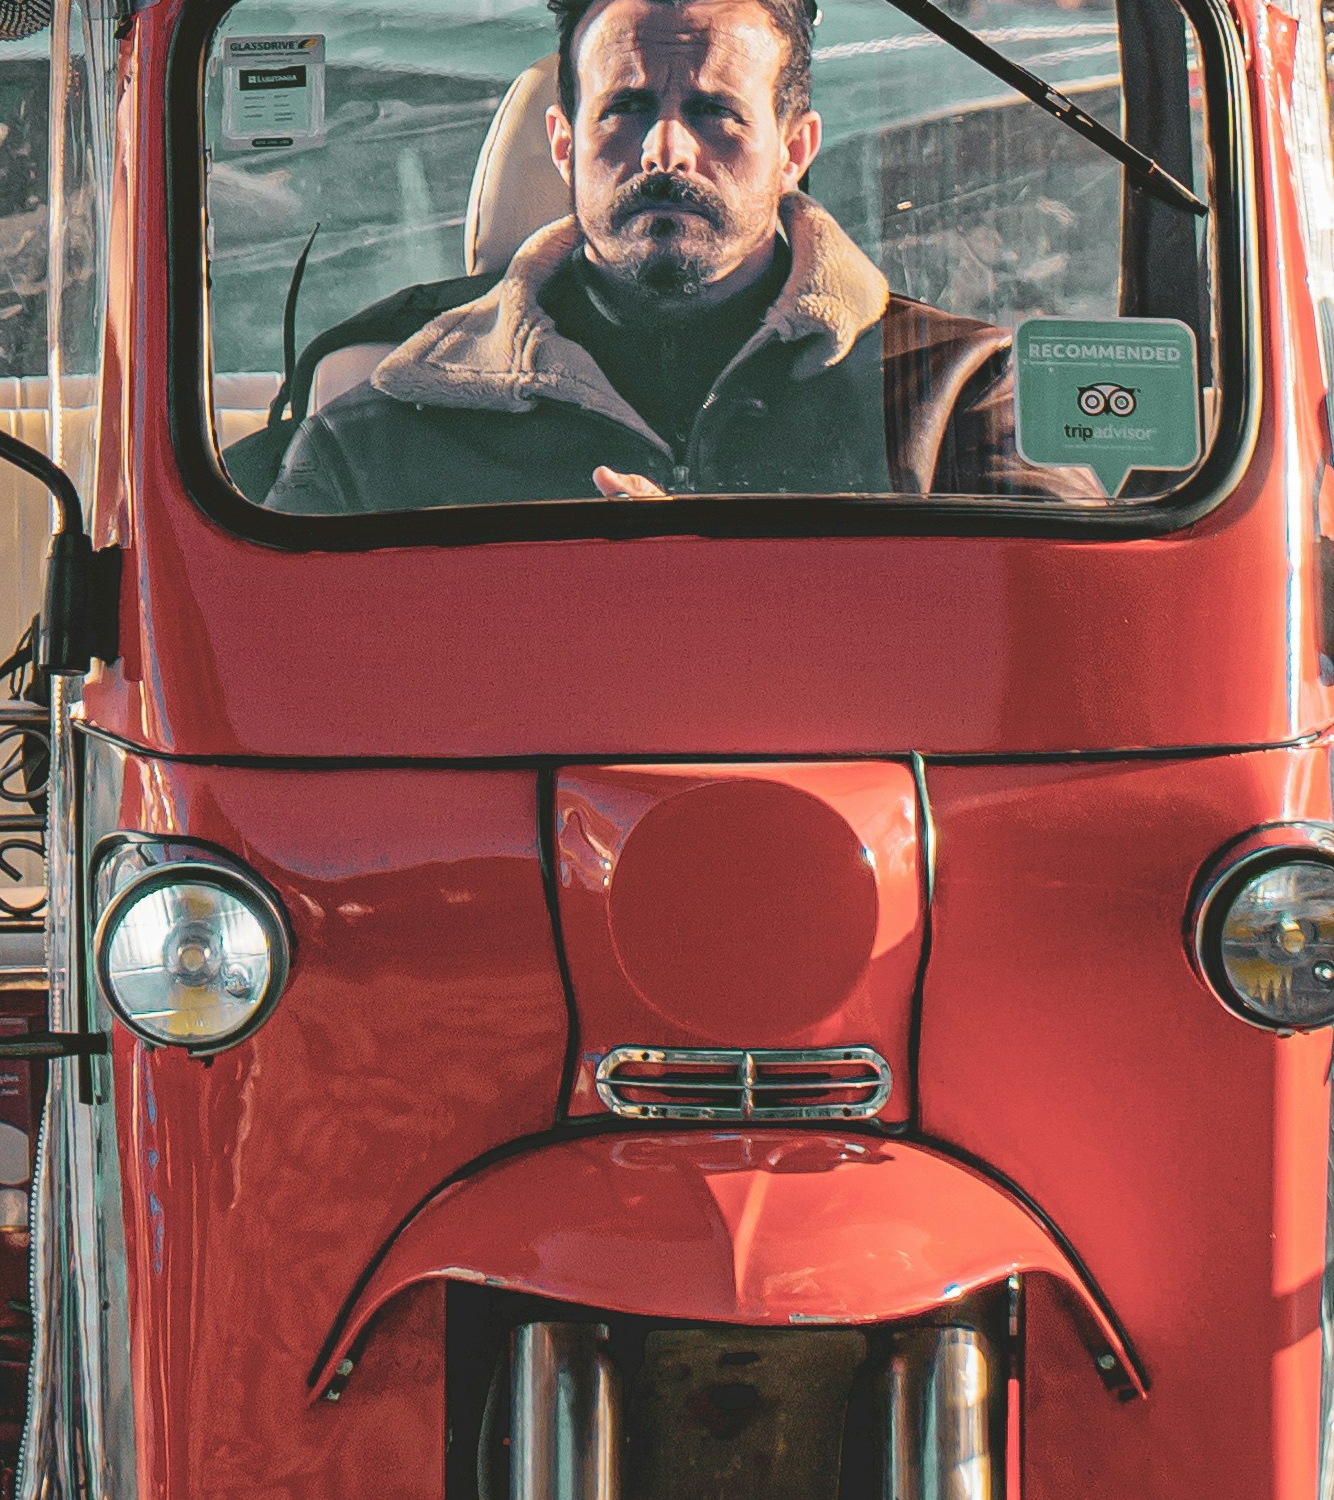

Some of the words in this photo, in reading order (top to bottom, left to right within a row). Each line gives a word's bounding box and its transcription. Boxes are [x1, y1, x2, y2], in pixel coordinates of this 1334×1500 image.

[230, 41, 295, 51] GLASSDRIVE
[1028, 343, 1181, 362] RECOMMENDED
[1063, 423, 1152, 441] tripadvisor
